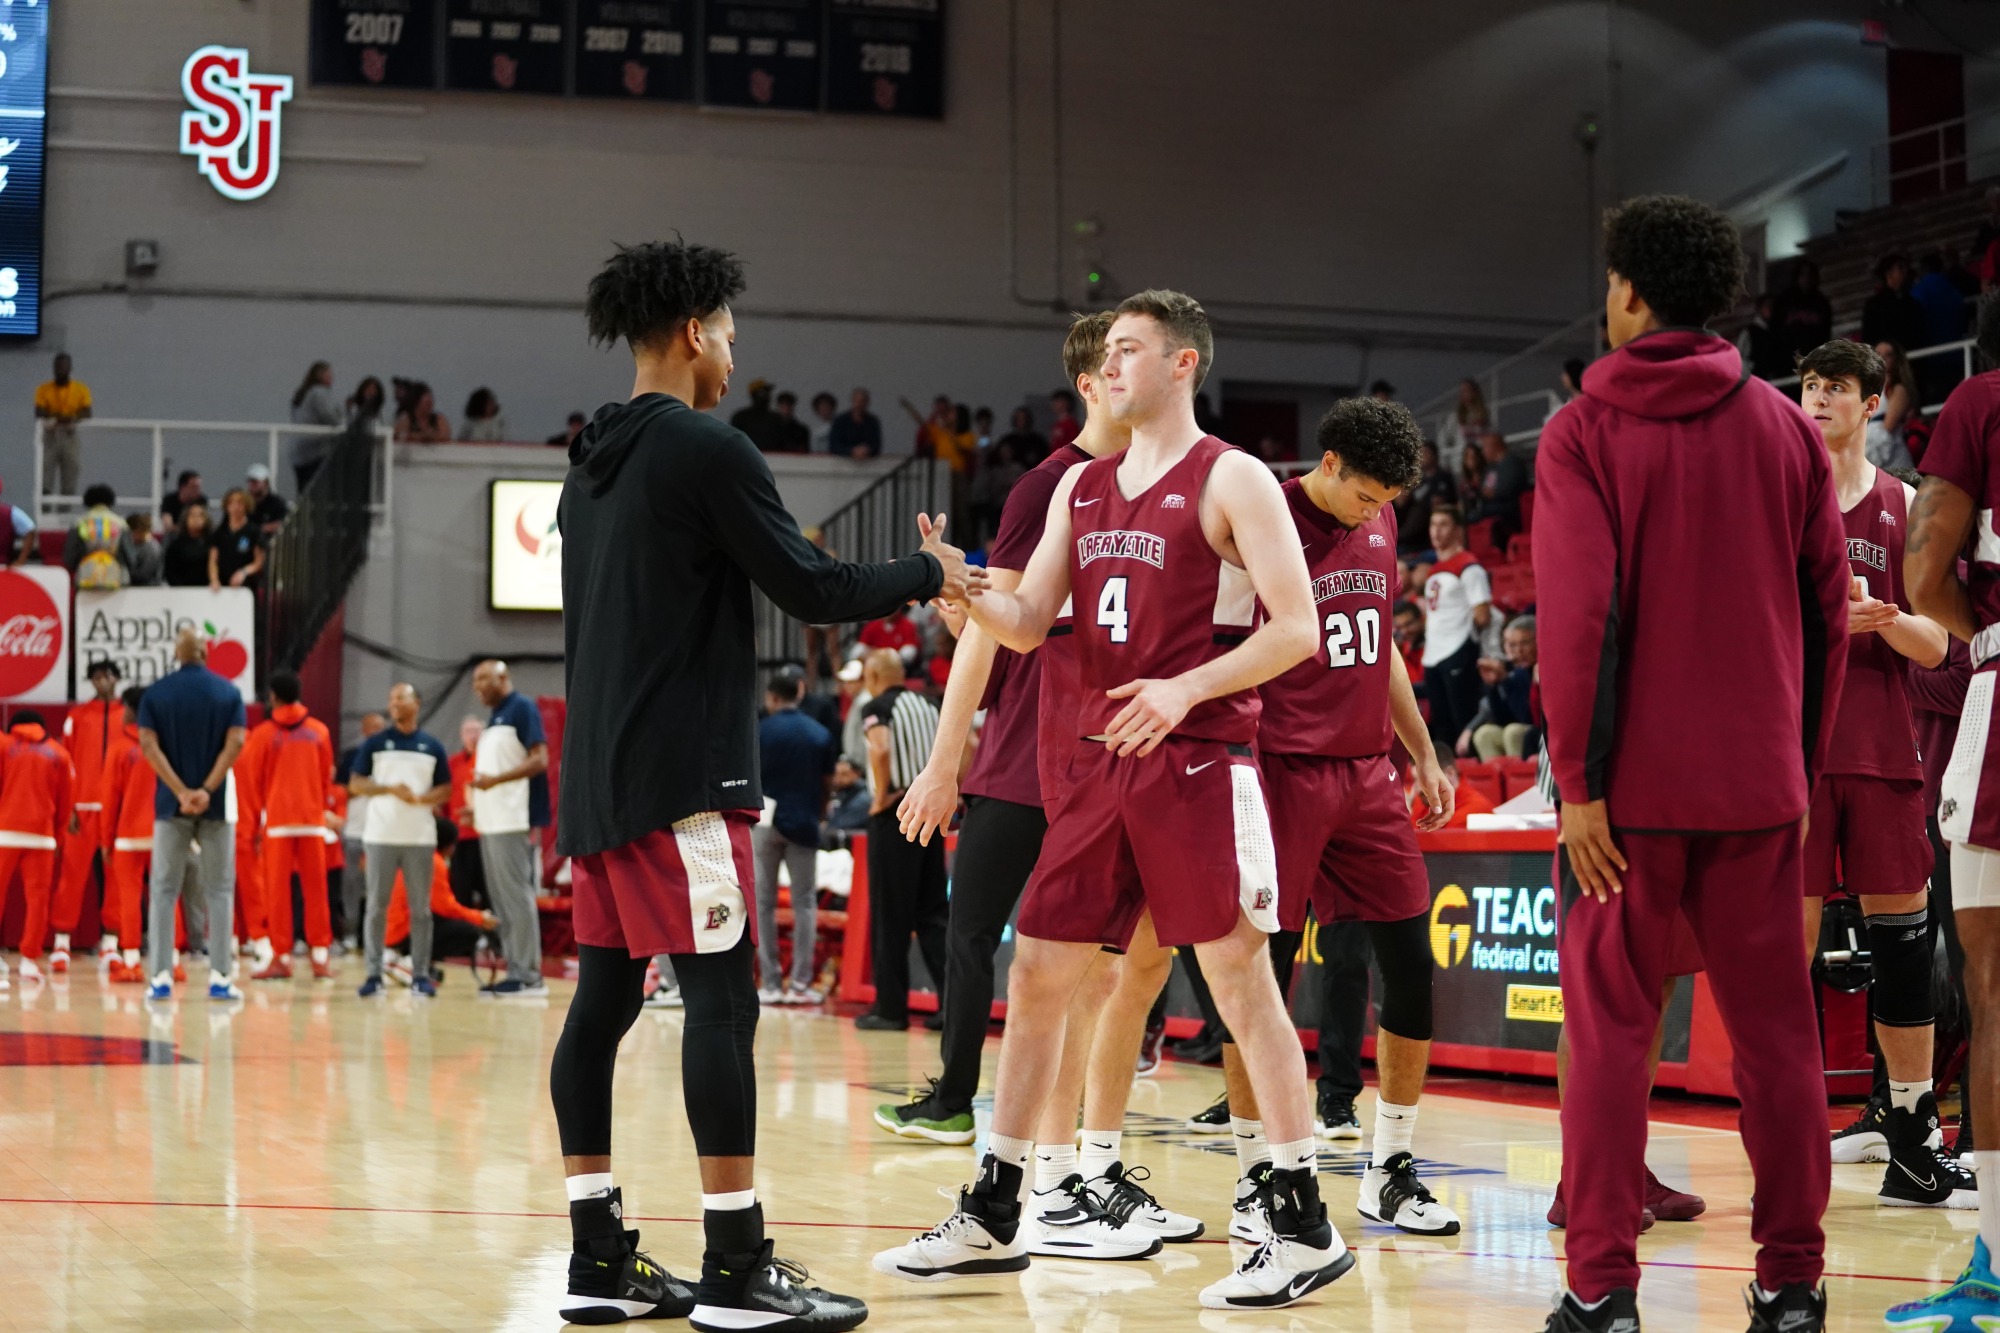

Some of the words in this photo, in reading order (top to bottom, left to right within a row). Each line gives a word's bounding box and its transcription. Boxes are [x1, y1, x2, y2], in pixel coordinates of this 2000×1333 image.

[346, 12, 404, 44] 2007
[1079, 531, 1163, 566] LAFAYETTE
[1312, 571, 1386, 601] LAFAYETTE
[1097, 577, 1128, 642] 4
[1325, 608, 1380, 667] 20
[1472, 887, 1558, 936] TEAC
[1472, 940, 1531, 971] federal
[1534, 949, 1559, 973] cre
[1511, 992, 1546, 1012] Smart
